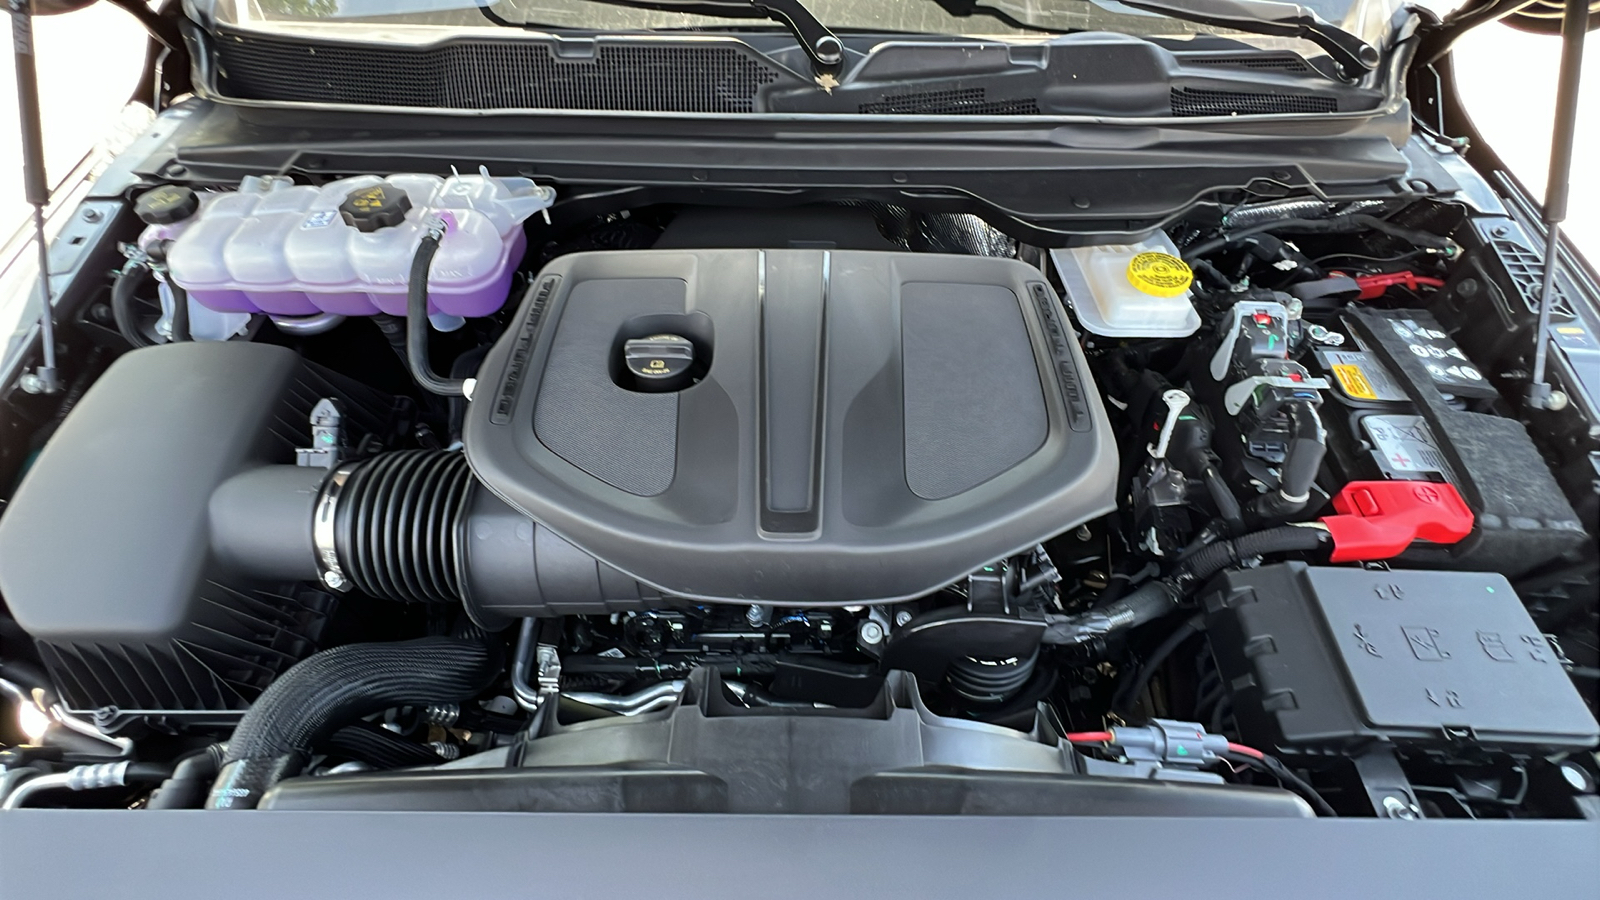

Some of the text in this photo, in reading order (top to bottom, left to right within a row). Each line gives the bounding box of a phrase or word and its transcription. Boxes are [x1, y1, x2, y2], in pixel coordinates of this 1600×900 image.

[497, 332, 533, 416] TURBO
[1033, 284, 1084, 423] TWIN TURBO
